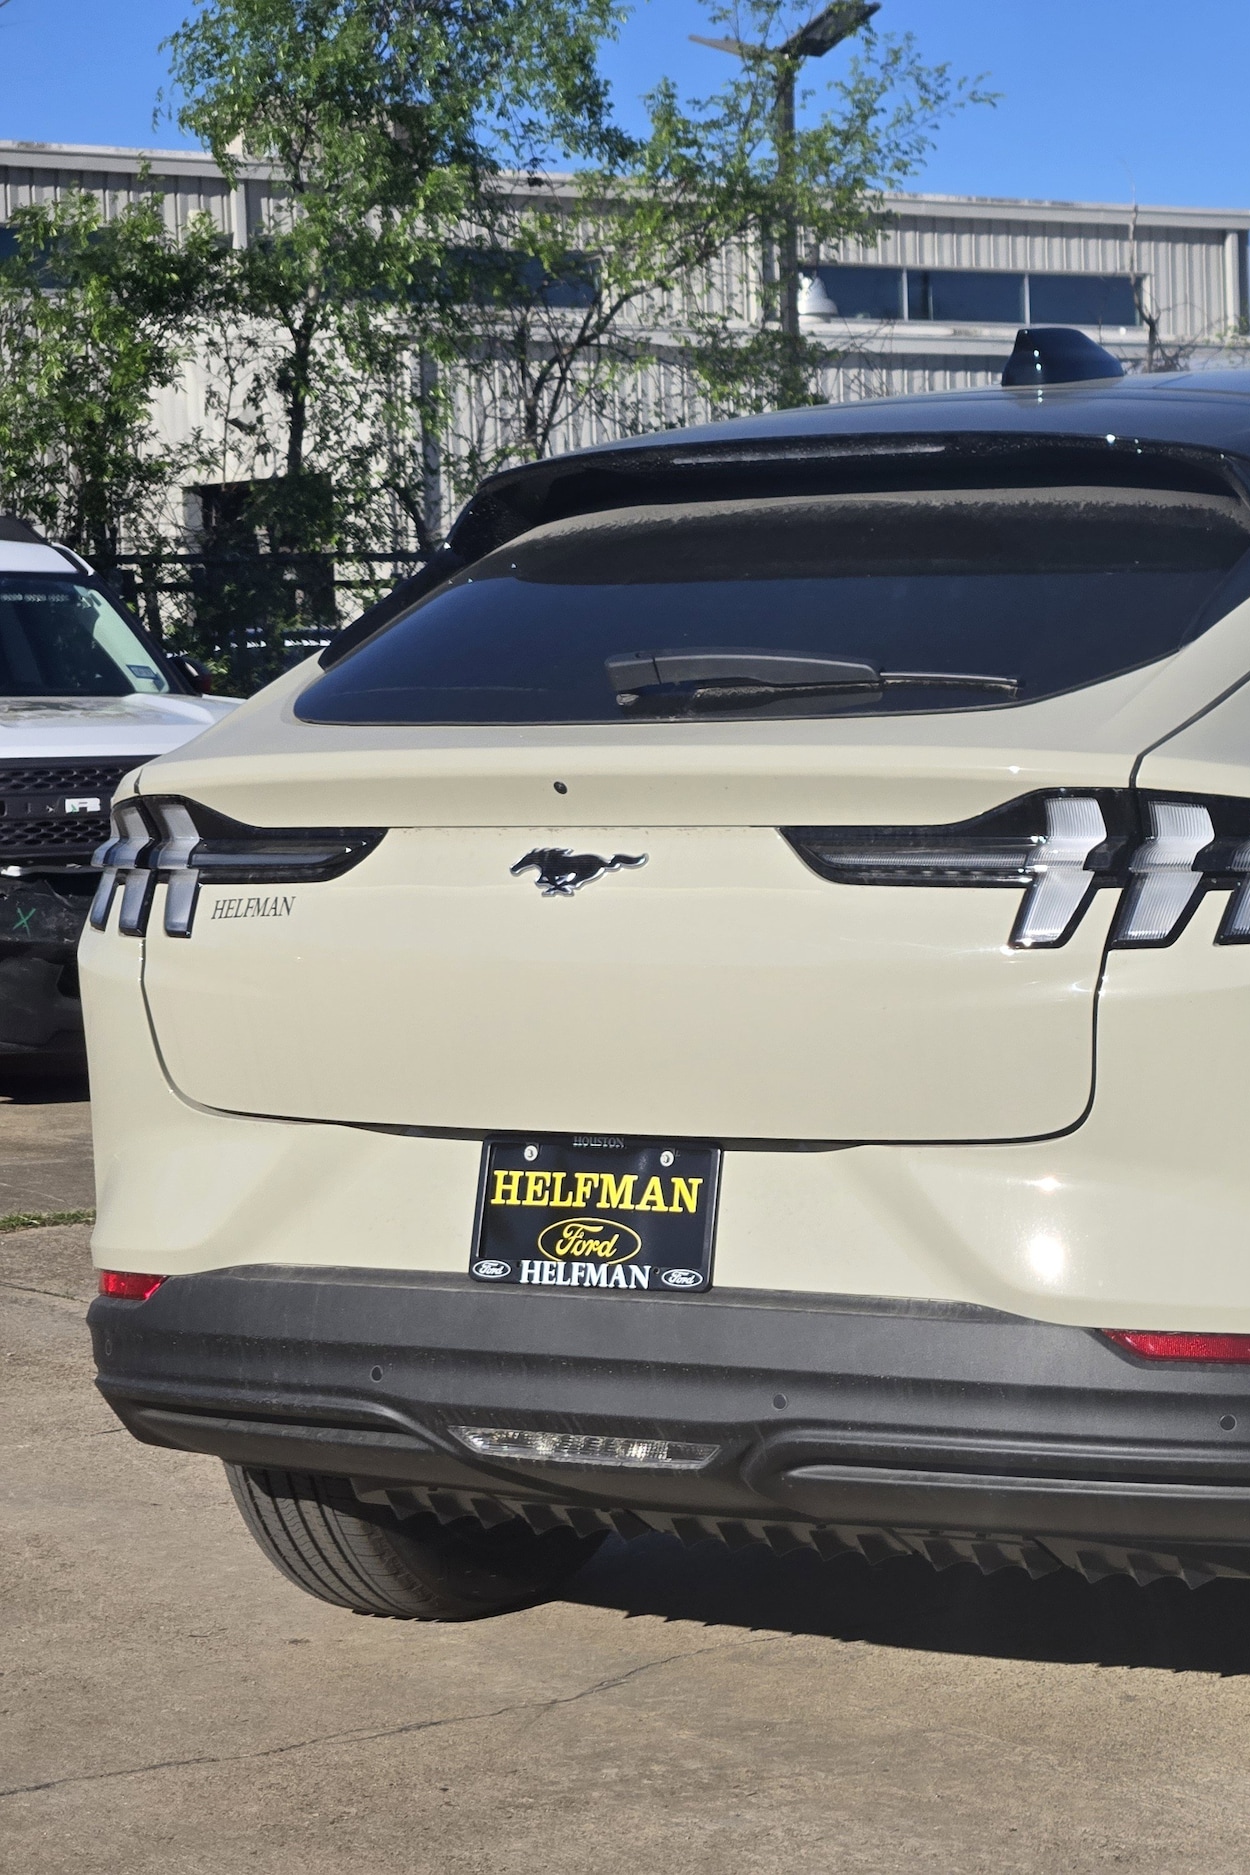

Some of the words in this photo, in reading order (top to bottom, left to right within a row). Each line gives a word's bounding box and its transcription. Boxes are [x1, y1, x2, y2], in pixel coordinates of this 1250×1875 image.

[211, 896, 296, 920] HELFMAN
[572, 1136, 625, 1149] HOUSTON
[491, 1170, 703, 1213] HELFMAN
[555, 1223, 620, 1258] Ford
[519, 1260, 651, 1290] HELFMAN
